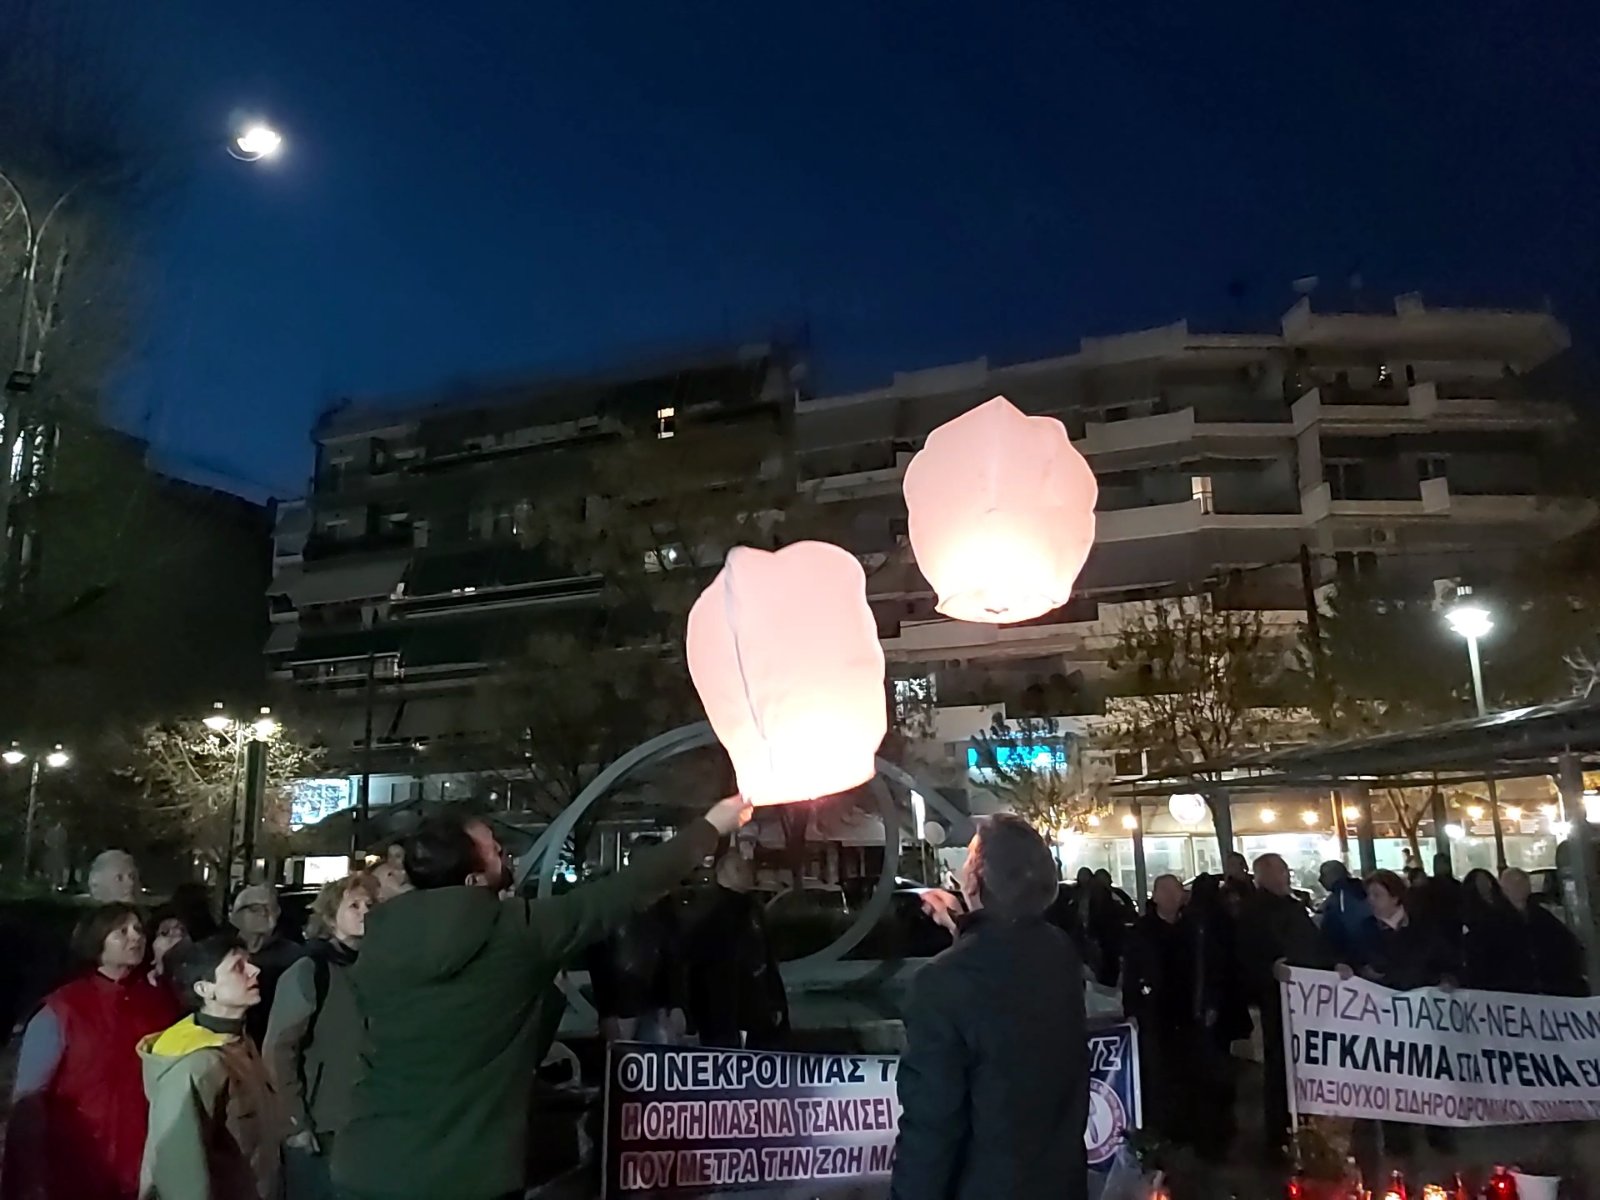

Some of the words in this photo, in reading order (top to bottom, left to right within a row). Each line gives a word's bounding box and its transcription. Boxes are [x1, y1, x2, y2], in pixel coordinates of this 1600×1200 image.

[618, 1052, 657, 1092] ΟΙ
[664, 1053, 790, 1091] ΝΕΚΡΟΙ
[797, 1056, 866, 1087] ΜΑΣ
[1304, 1029, 1455, 1082] ΕΓΚΛΗΜΑ
[1456, 1052, 1484, 1084] ΣΤΑ
[1481, 1048, 1581, 1088] ΤΡΕΝΑ
[621, 1102, 641, 1140] Η
[643, 1101, 707, 1140] ΟΡΓΗ
[708, 1099, 759, 1139] ΜΑΣ
[760, 1098, 795, 1137] ΝΑ
[795, 1097, 895, 1136] ΤΣΑΚΙΣΕΙ
[620, 1151, 675, 1190] ΠΟΥ
[676, 1149, 760, 1187] ΜΕΤΡΑ
[762, 1147, 814, 1181] ΤΗΝ
[813, 1145, 865, 1179] ΖΩΗ
